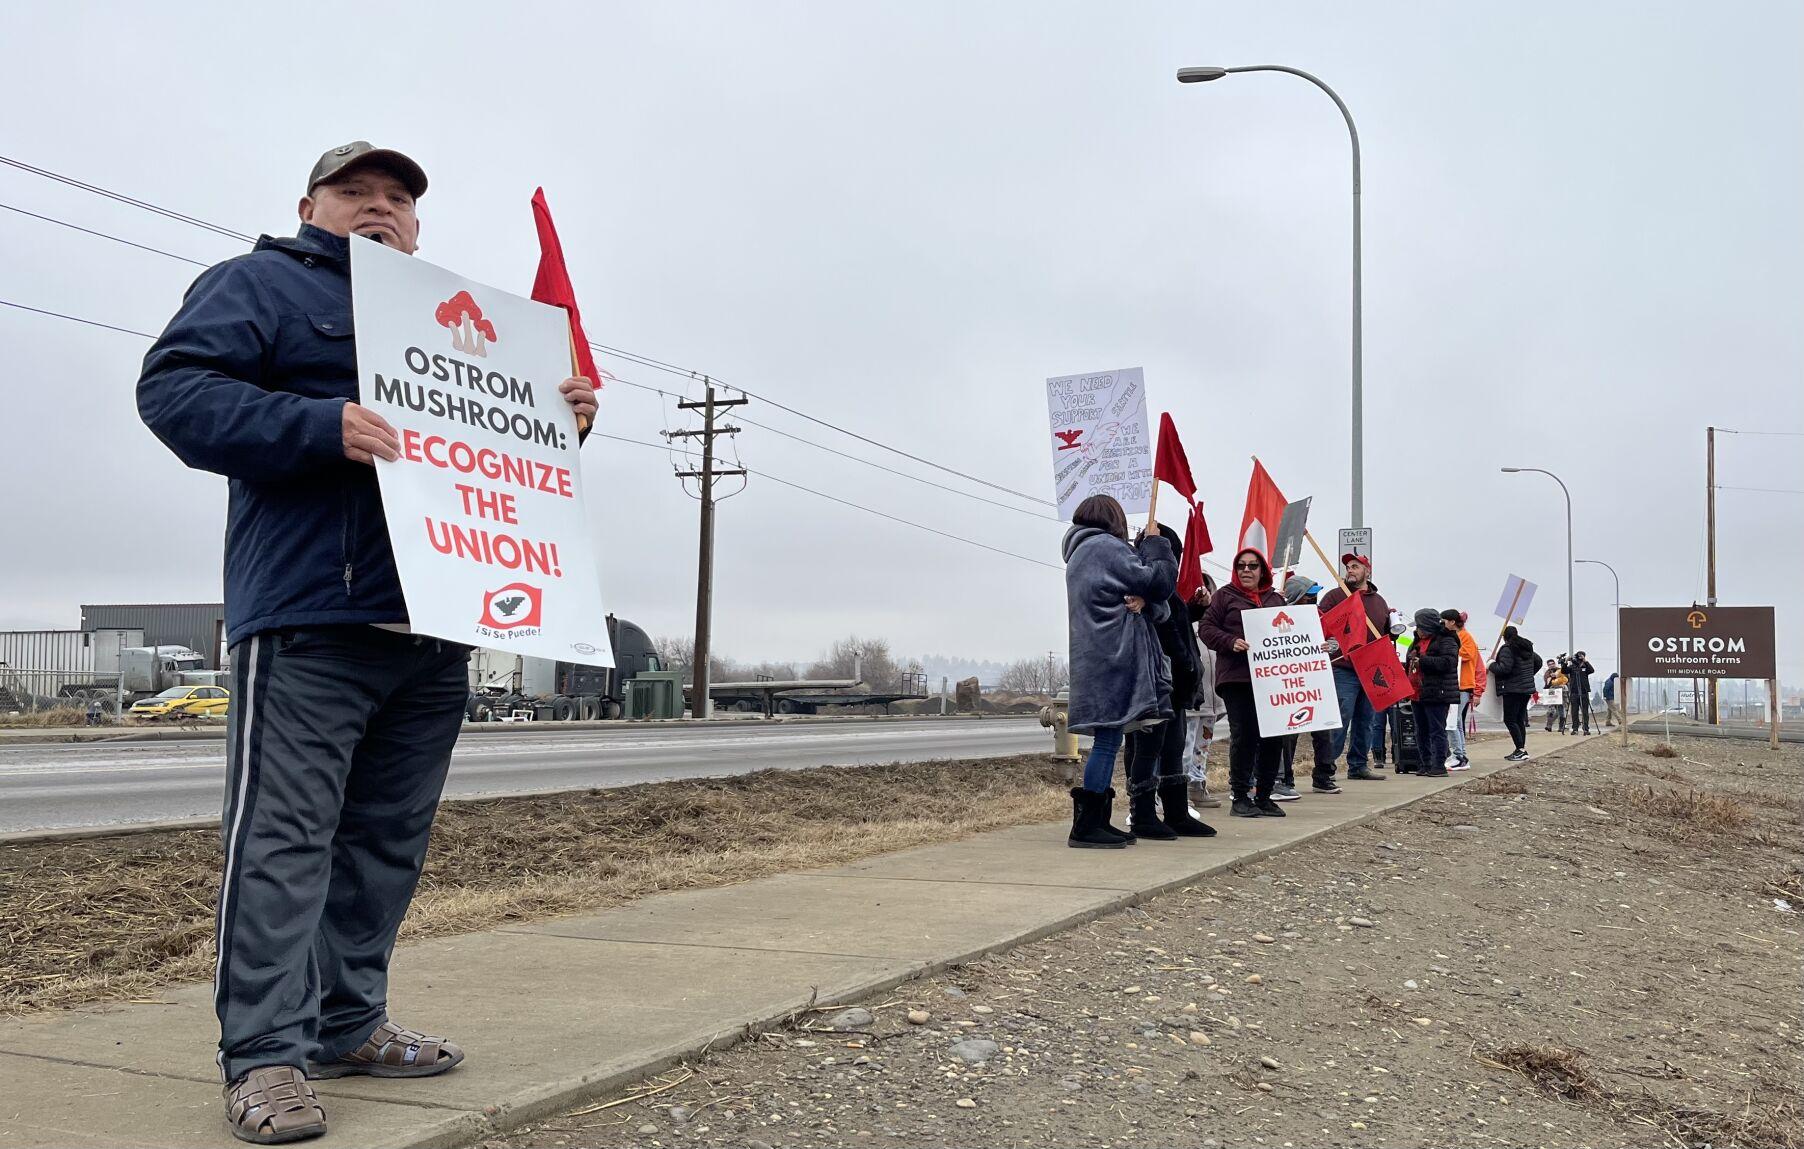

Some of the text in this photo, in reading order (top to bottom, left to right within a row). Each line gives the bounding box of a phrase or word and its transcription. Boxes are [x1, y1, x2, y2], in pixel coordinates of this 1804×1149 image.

[404, 346, 535, 408] OSTROM
[1049, 375, 1113, 397] WE NEED
[1060, 393, 1096, 409] YOUR
[374, 373, 567, 451] MUSHROOM:
[1051, 407, 1103, 429] SUPPORT
[399, 429, 574, 498] ECOGNIZE
[455, 483, 519, 525] THE
[1342, 530, 1368, 538] CENTER
[424, 516, 563, 579] UNION!
[507, 628, 542, 640] Puede!
[1262, 633, 1311, 648] OSTROM
[1648, 637, 1746, 653] OSTROM
[1655, 653, 1741, 664] mushroom farms
[1254, 659, 1328, 679] RECOGNIZE
[1281, 676, 1306, 690] THE
[1269, 688, 1323, 707] UNION!
